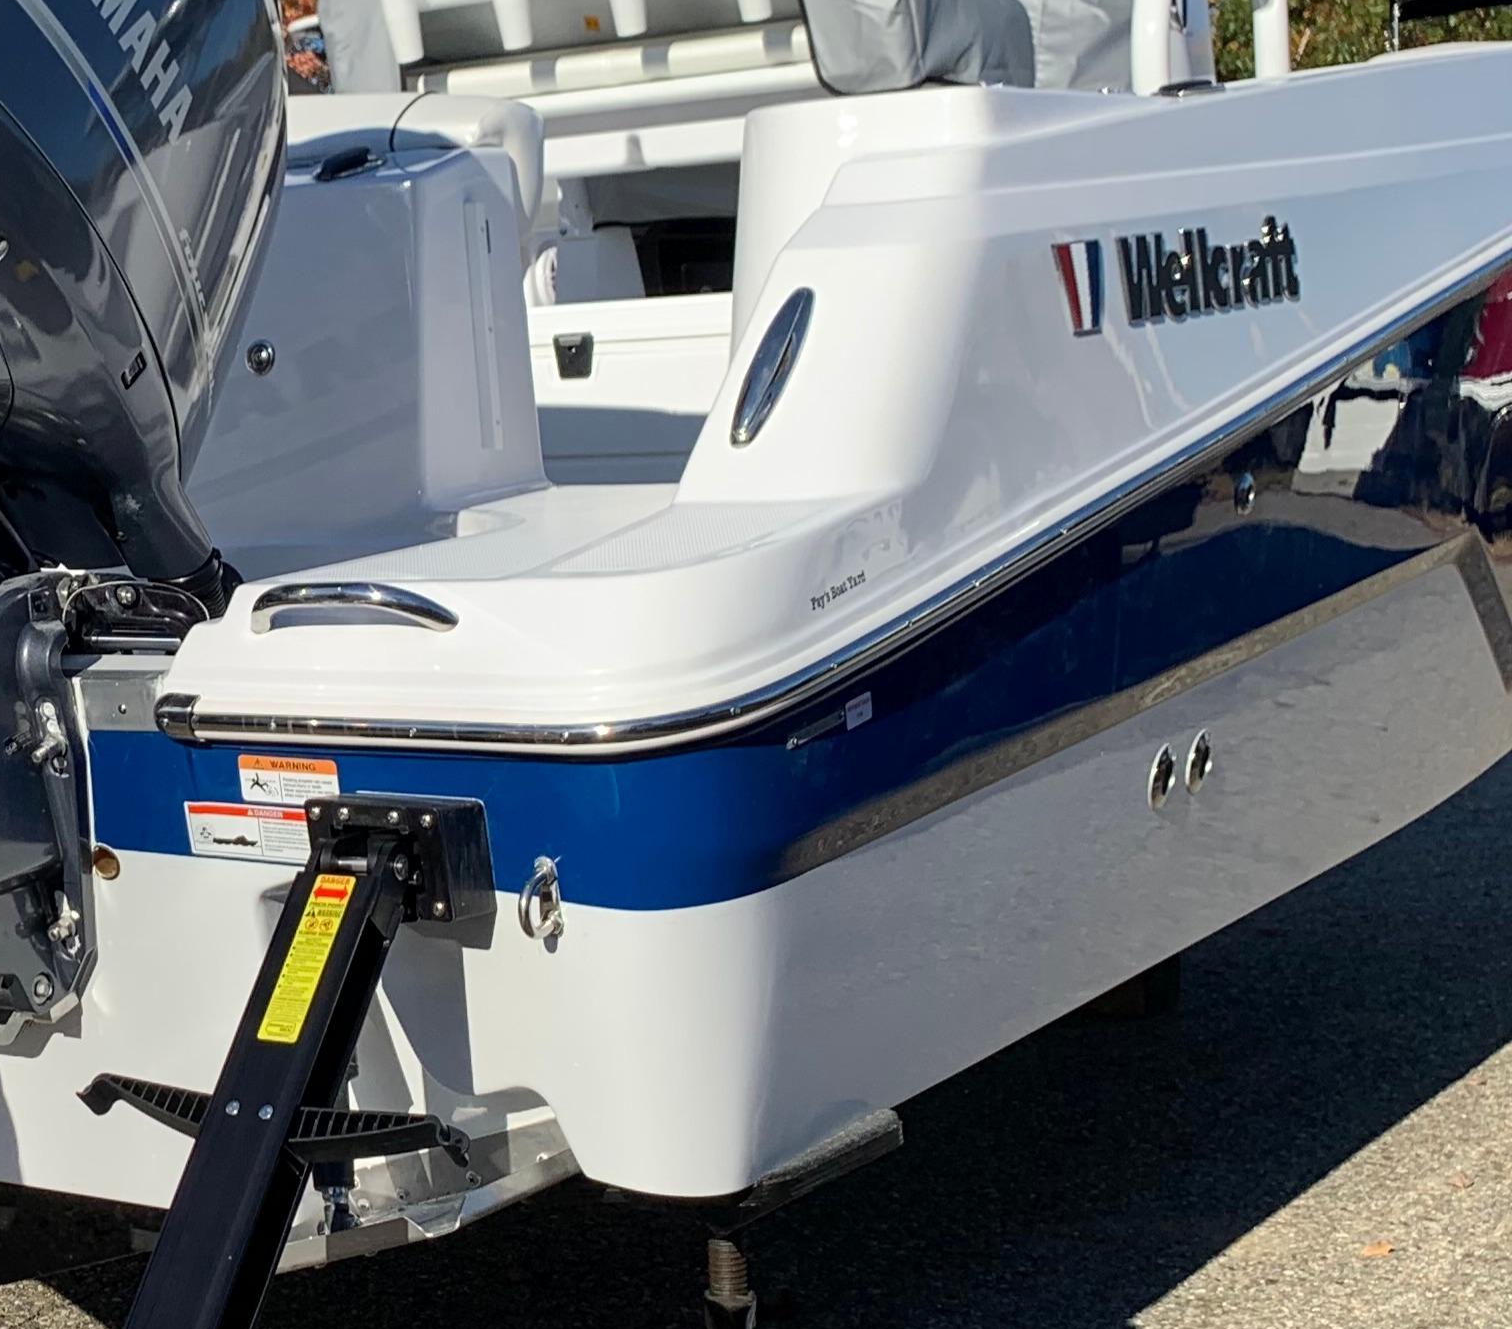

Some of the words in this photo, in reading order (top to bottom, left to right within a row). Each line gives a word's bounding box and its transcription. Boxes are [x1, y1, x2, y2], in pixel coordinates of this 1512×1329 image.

[1115, 215, 1300, 328] Wellcraft
[830, 581, 847, 599] Boat
[847, 570, 866, 589] Yard
[268, 759, 317, 771] WARNING
